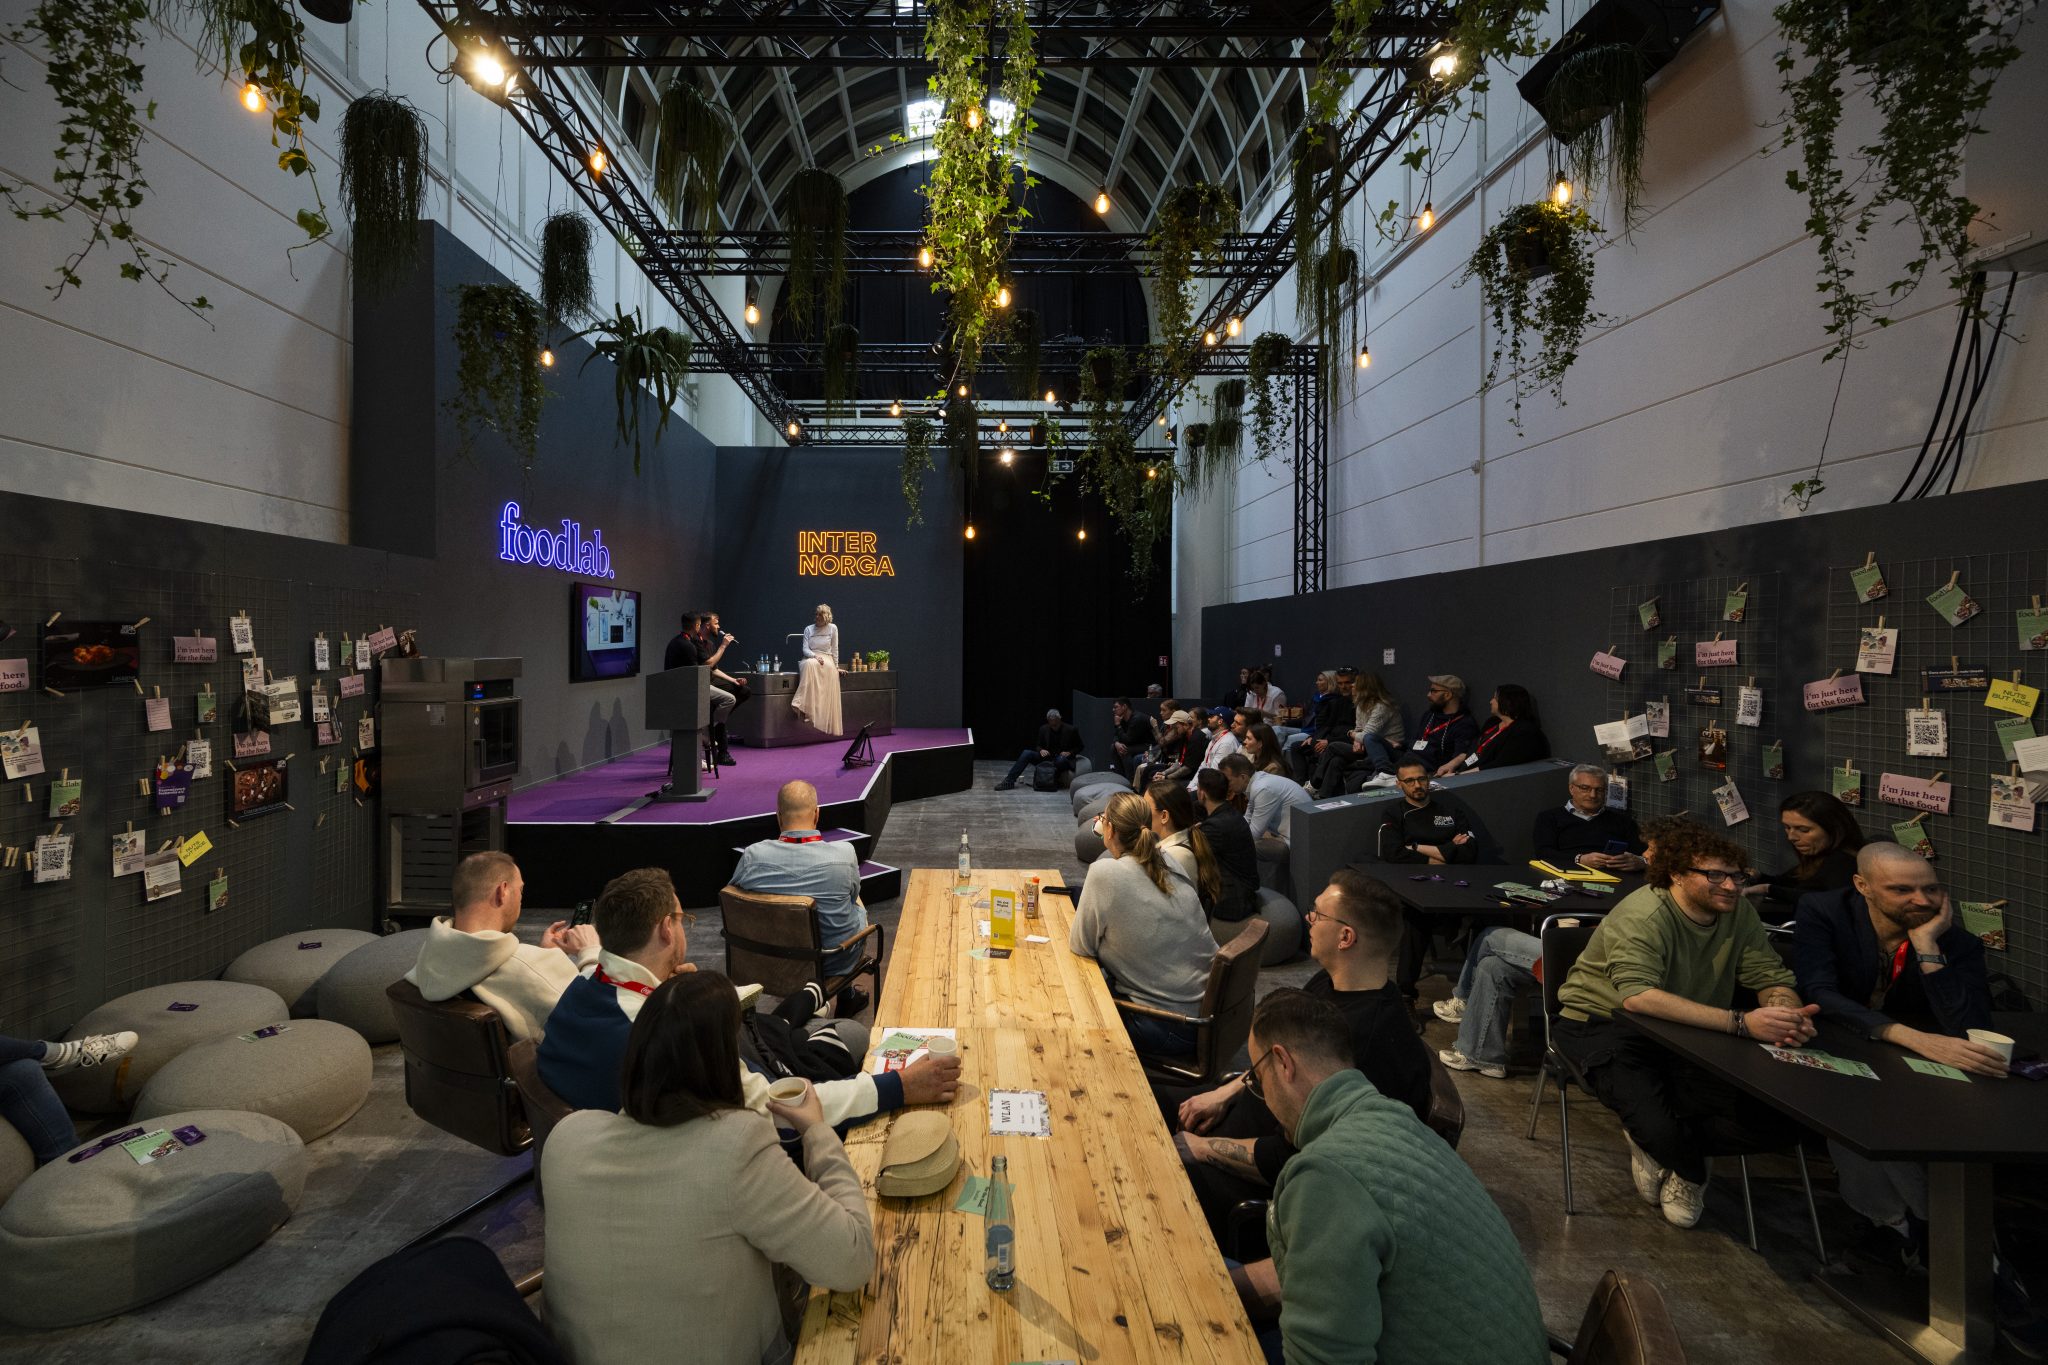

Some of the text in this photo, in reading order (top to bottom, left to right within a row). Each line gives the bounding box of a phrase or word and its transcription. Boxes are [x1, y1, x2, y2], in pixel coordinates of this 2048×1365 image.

[500, 501, 615, 580] foodlab.
[799, 531, 877, 553] INTER
[799, 554, 895, 577] NORGA
[2, 672, 26, 680] here
[0, 681, 25, 690] food.
[1821, 689, 1837, 699] just
[1838, 687, 1858, 695] here
[1992, 693, 2010, 702] BUT
[2002, 689, 2027, 700] NUTS
[1807, 701, 1820, 709] for
[1881, 784, 1946, 803] i'm just here
[1881, 793, 1896, 802] for
[1897, 797, 1914, 807] the
[1001, 1100, 1011, 1123] WLAN
